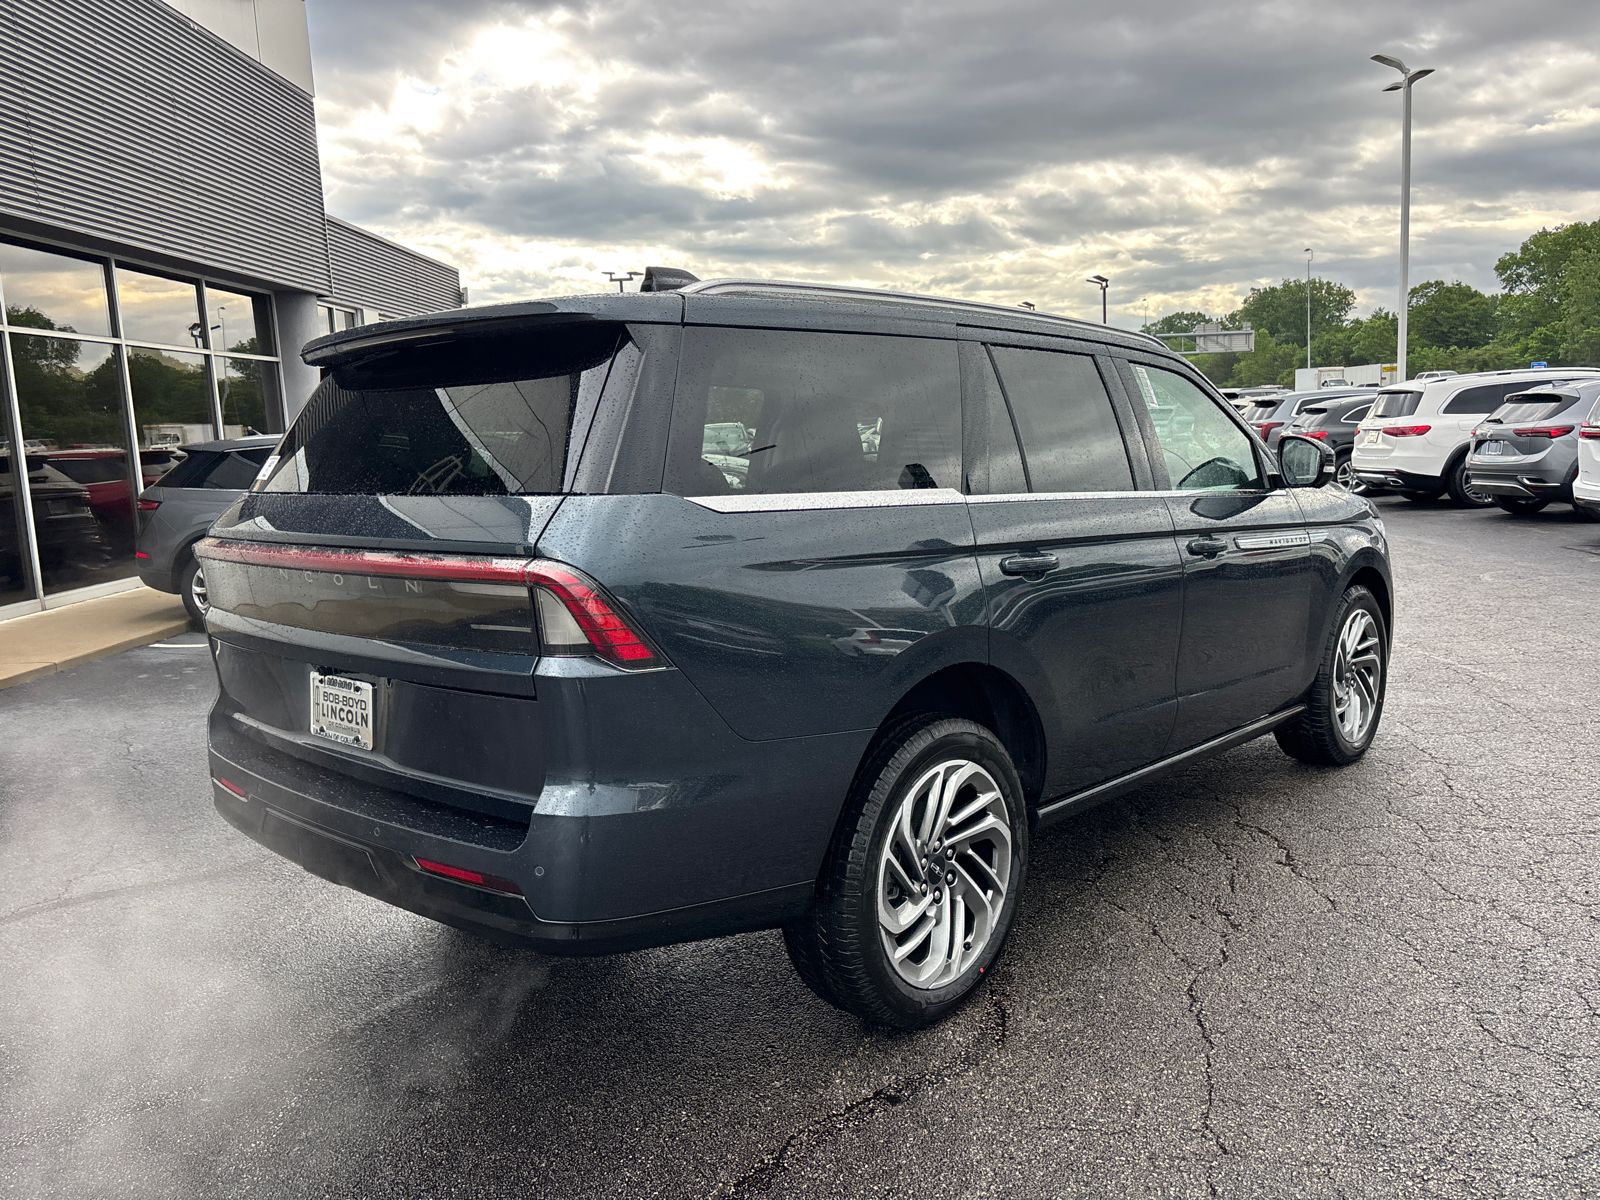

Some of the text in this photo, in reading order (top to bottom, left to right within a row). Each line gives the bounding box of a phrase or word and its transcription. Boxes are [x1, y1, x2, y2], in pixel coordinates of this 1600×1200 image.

[1269, 536, 1307, 545] NAVIGATOR
[238, 567, 420, 593] LINCOLN
[323, 691, 367, 711] BOB-BOYD
[321, 703, 369, 728] LINCOLN
[335, 722, 361, 734] COLUMBUS
